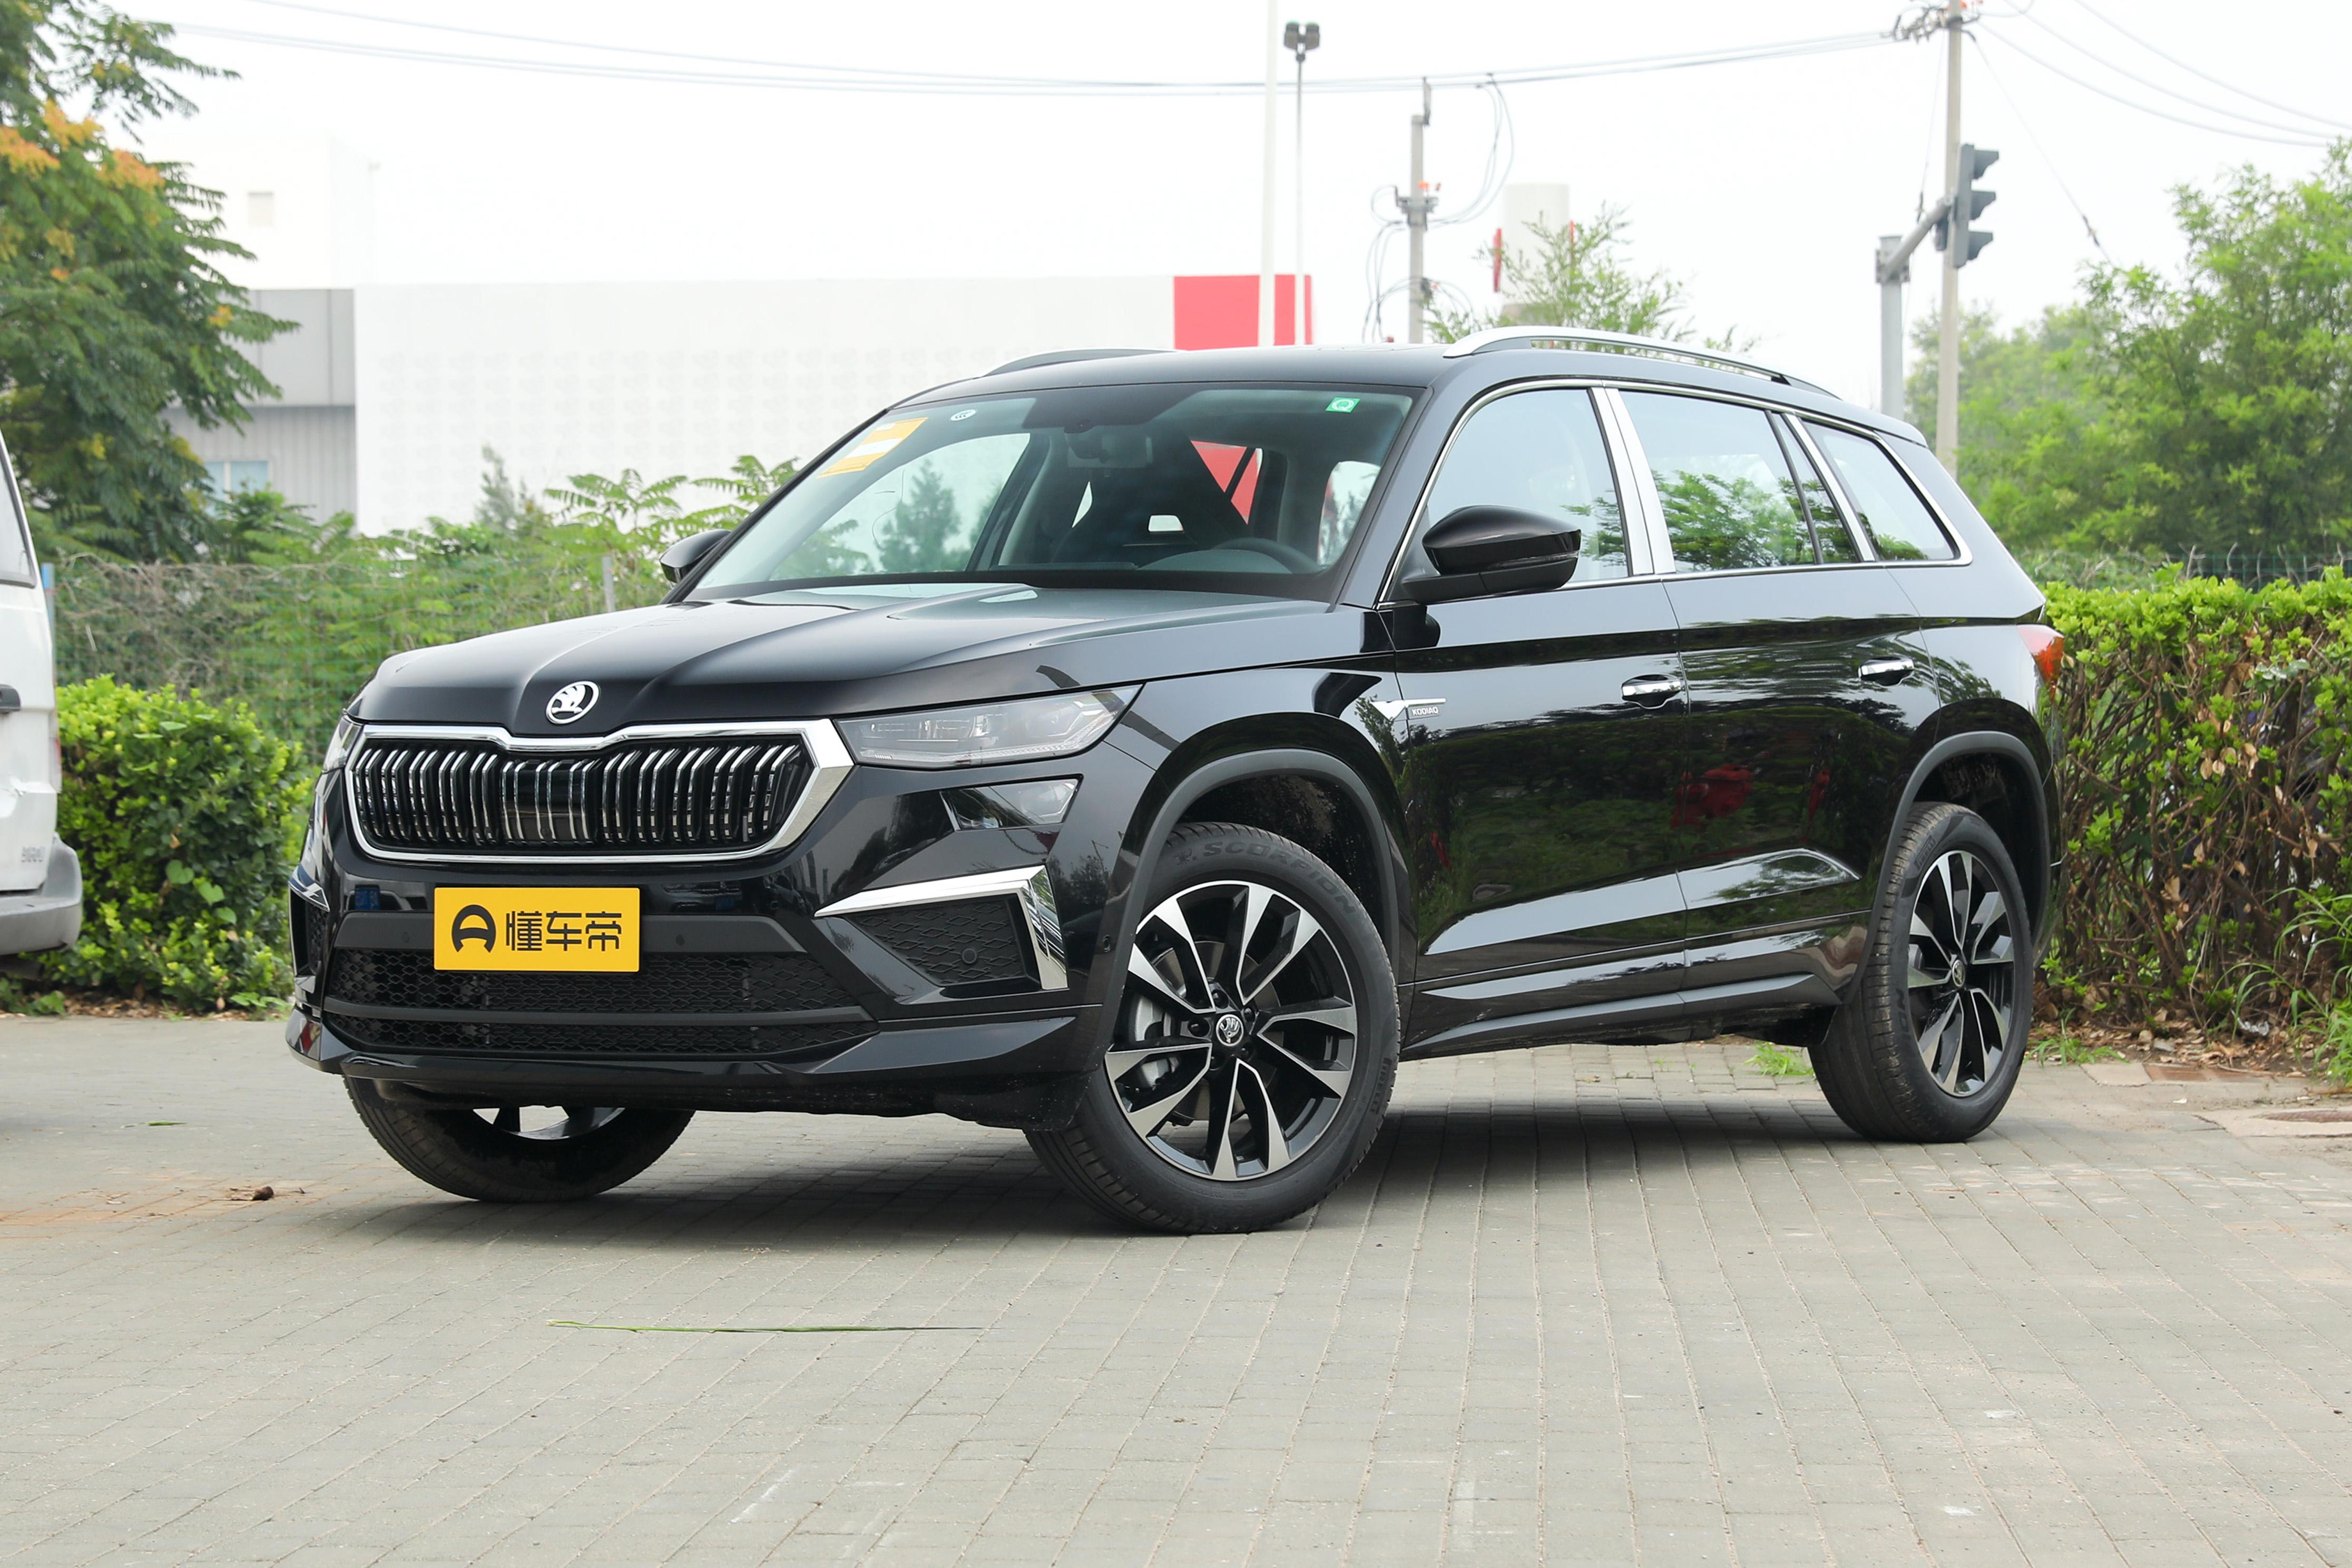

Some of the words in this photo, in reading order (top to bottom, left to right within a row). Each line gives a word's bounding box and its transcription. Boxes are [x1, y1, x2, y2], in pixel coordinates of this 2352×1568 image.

[1412, 706, 1439, 716] KODIAQ
[1202, 841, 1356, 914] SCORPION
[506, 911, 622, 951] 懂车帝
